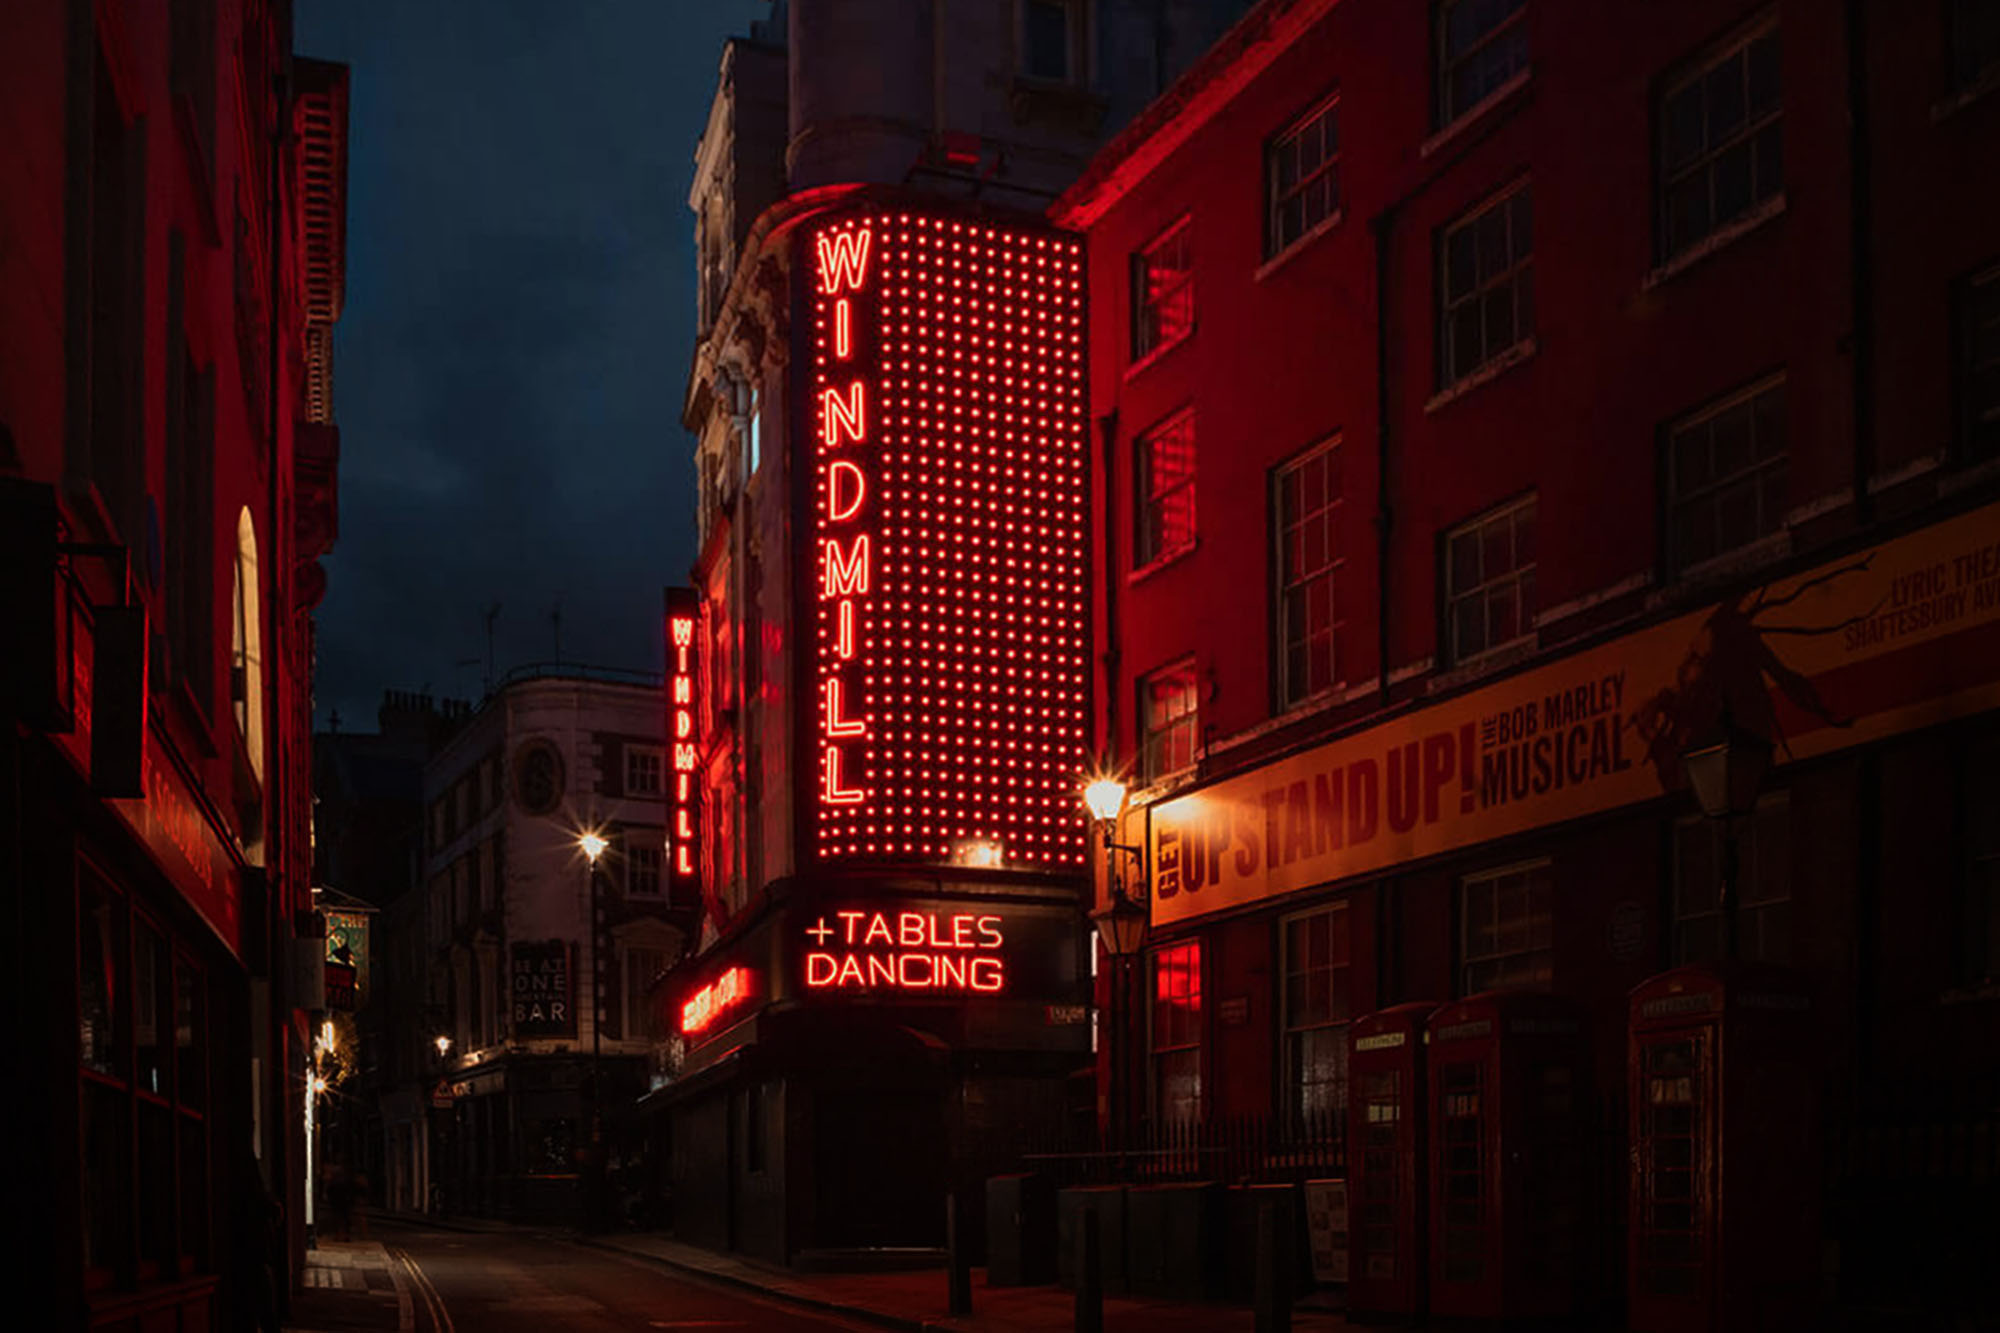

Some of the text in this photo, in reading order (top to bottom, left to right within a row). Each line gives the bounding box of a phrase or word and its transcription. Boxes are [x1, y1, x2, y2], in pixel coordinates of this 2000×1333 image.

[818, 228, 870, 803] WINDMILL
[1845, 588, 1967, 651] SHAFTESBURY
[1891, 563, 1947, 607] LYRIC
[1482, 669, 1626, 749] THE BOB MARLEY
[672, 617, 694, 874] WINDMILL
[1482, 714, 1632, 809] MUSICAL
[1158, 828, 1179, 899] GET
[1387, 722, 1476, 833] UP!
[515, 974, 566, 992] ONE
[808, 953, 1003, 990] DANCING
[515, 1001, 566, 1022] BAR
